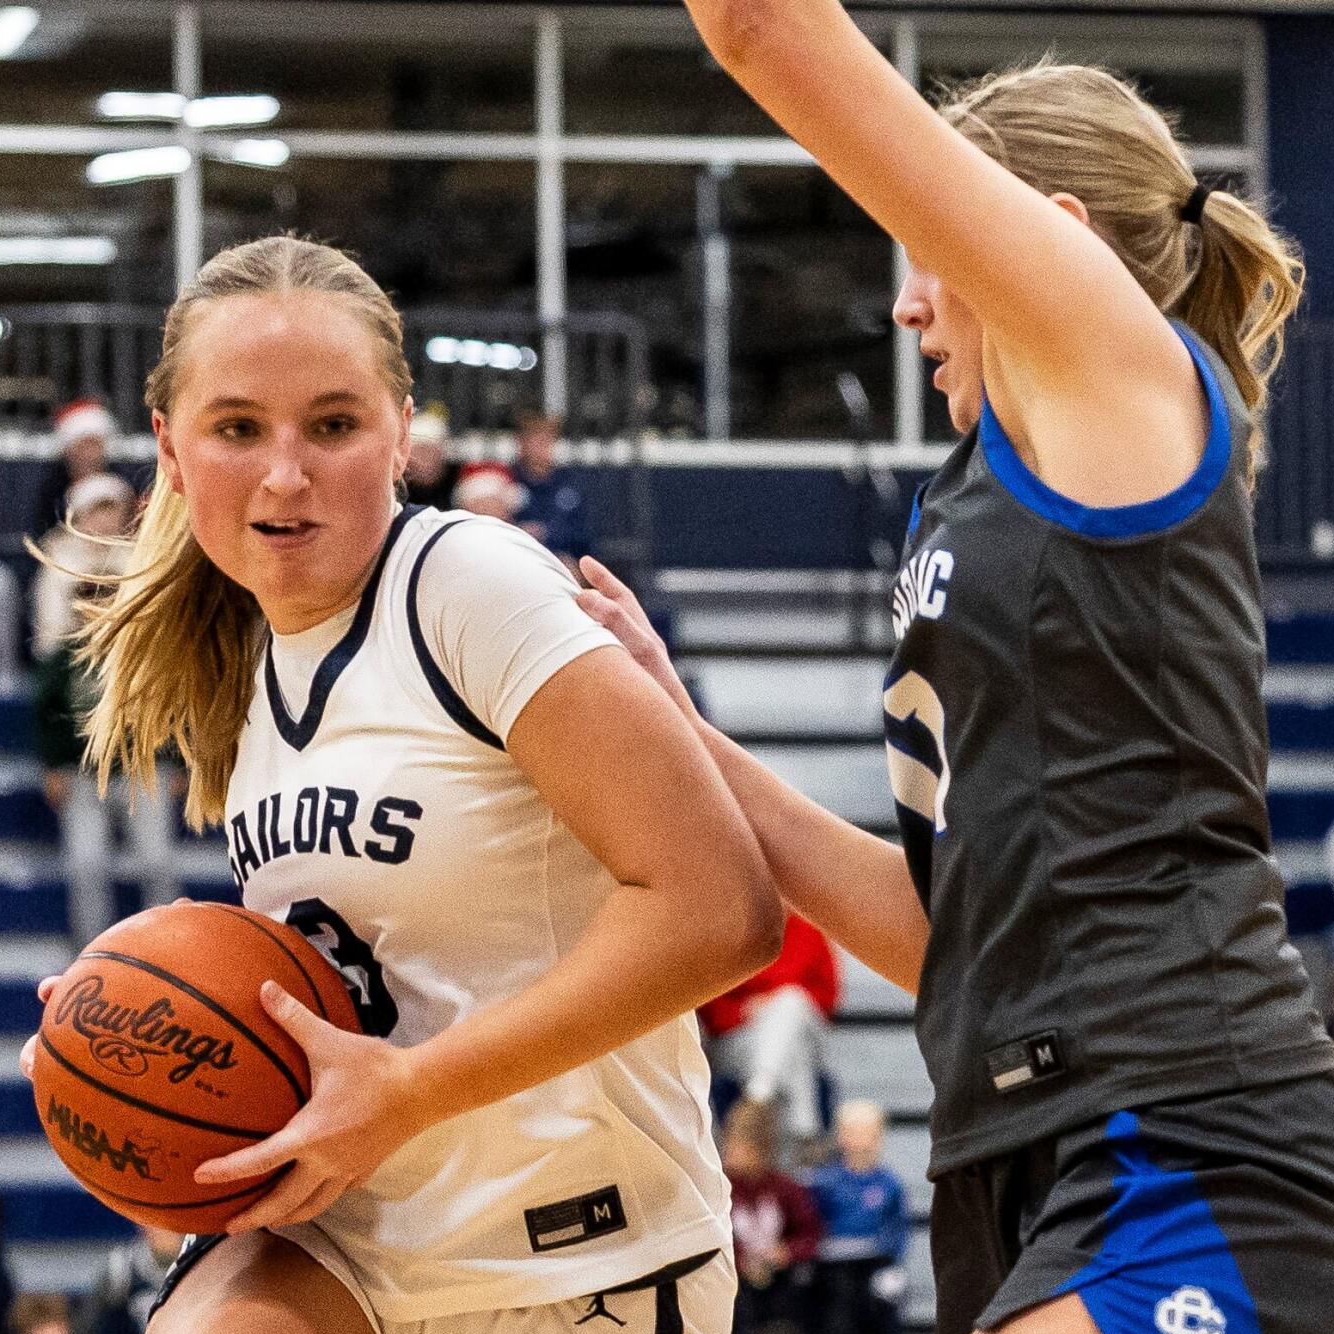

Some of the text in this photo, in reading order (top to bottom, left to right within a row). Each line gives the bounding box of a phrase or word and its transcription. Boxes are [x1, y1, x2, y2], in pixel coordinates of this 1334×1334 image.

[231, 786, 423, 893] AILORS
[55, 975, 239, 1084] Rawlings
[1036, 1044, 1055, 1066] M
[593, 1202, 611, 1222] M
